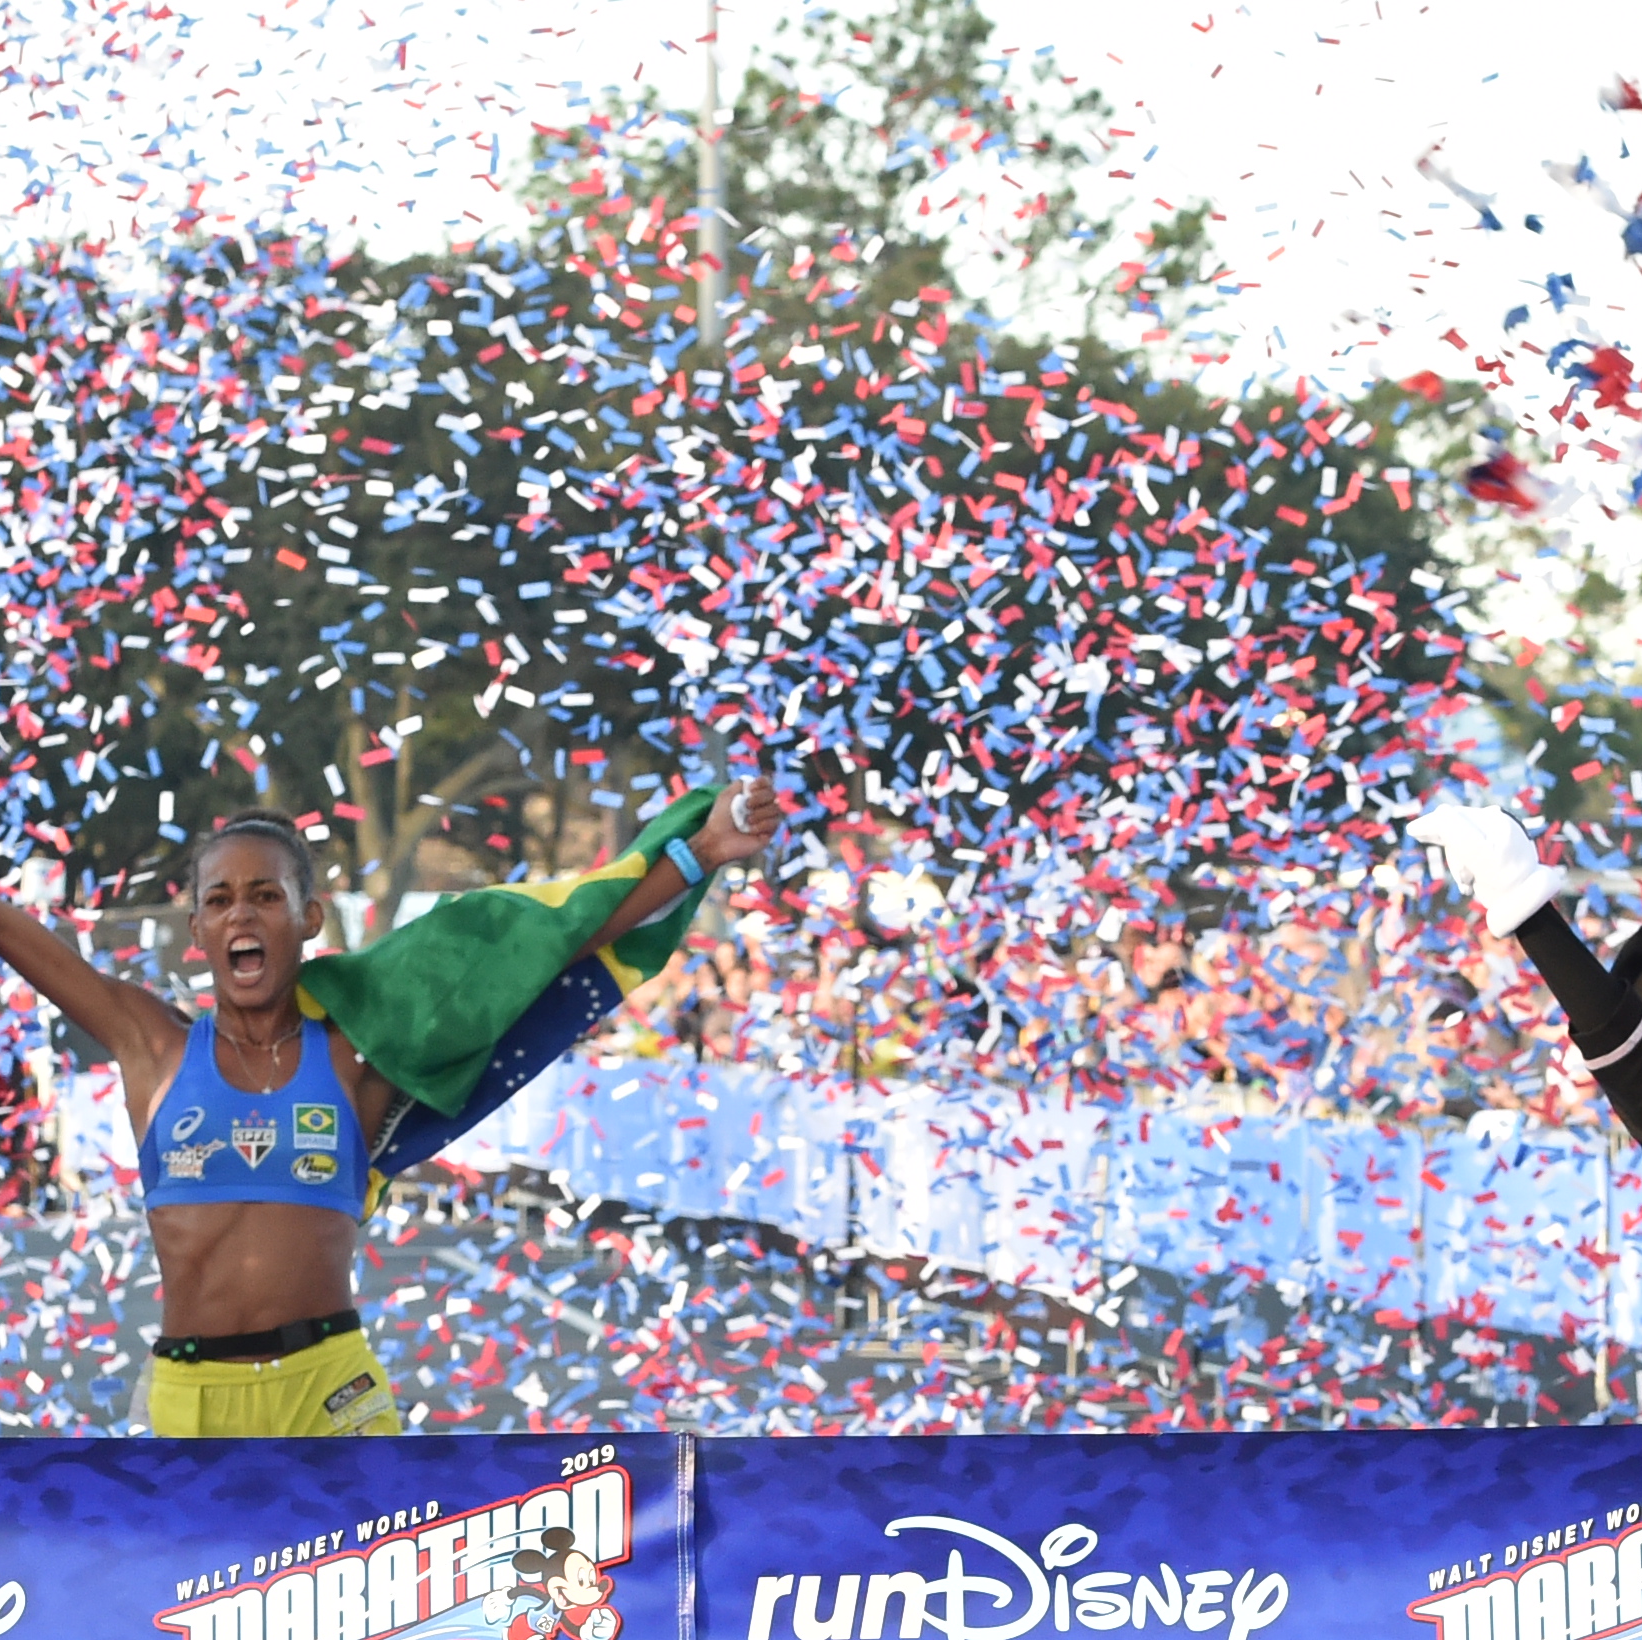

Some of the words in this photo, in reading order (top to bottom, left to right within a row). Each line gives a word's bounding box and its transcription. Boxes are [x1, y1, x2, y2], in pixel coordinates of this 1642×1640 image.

[561, 1444, 615, 1476] 2019
[176, 1563, 241, 1600] WALT
[253, 1529, 344, 1577] DISNEY
[357, 1500, 440, 1543] WORLD
[1428, 1554, 1493, 1592] WALT
[1504, 1518, 1594, 1567] DISNEY
